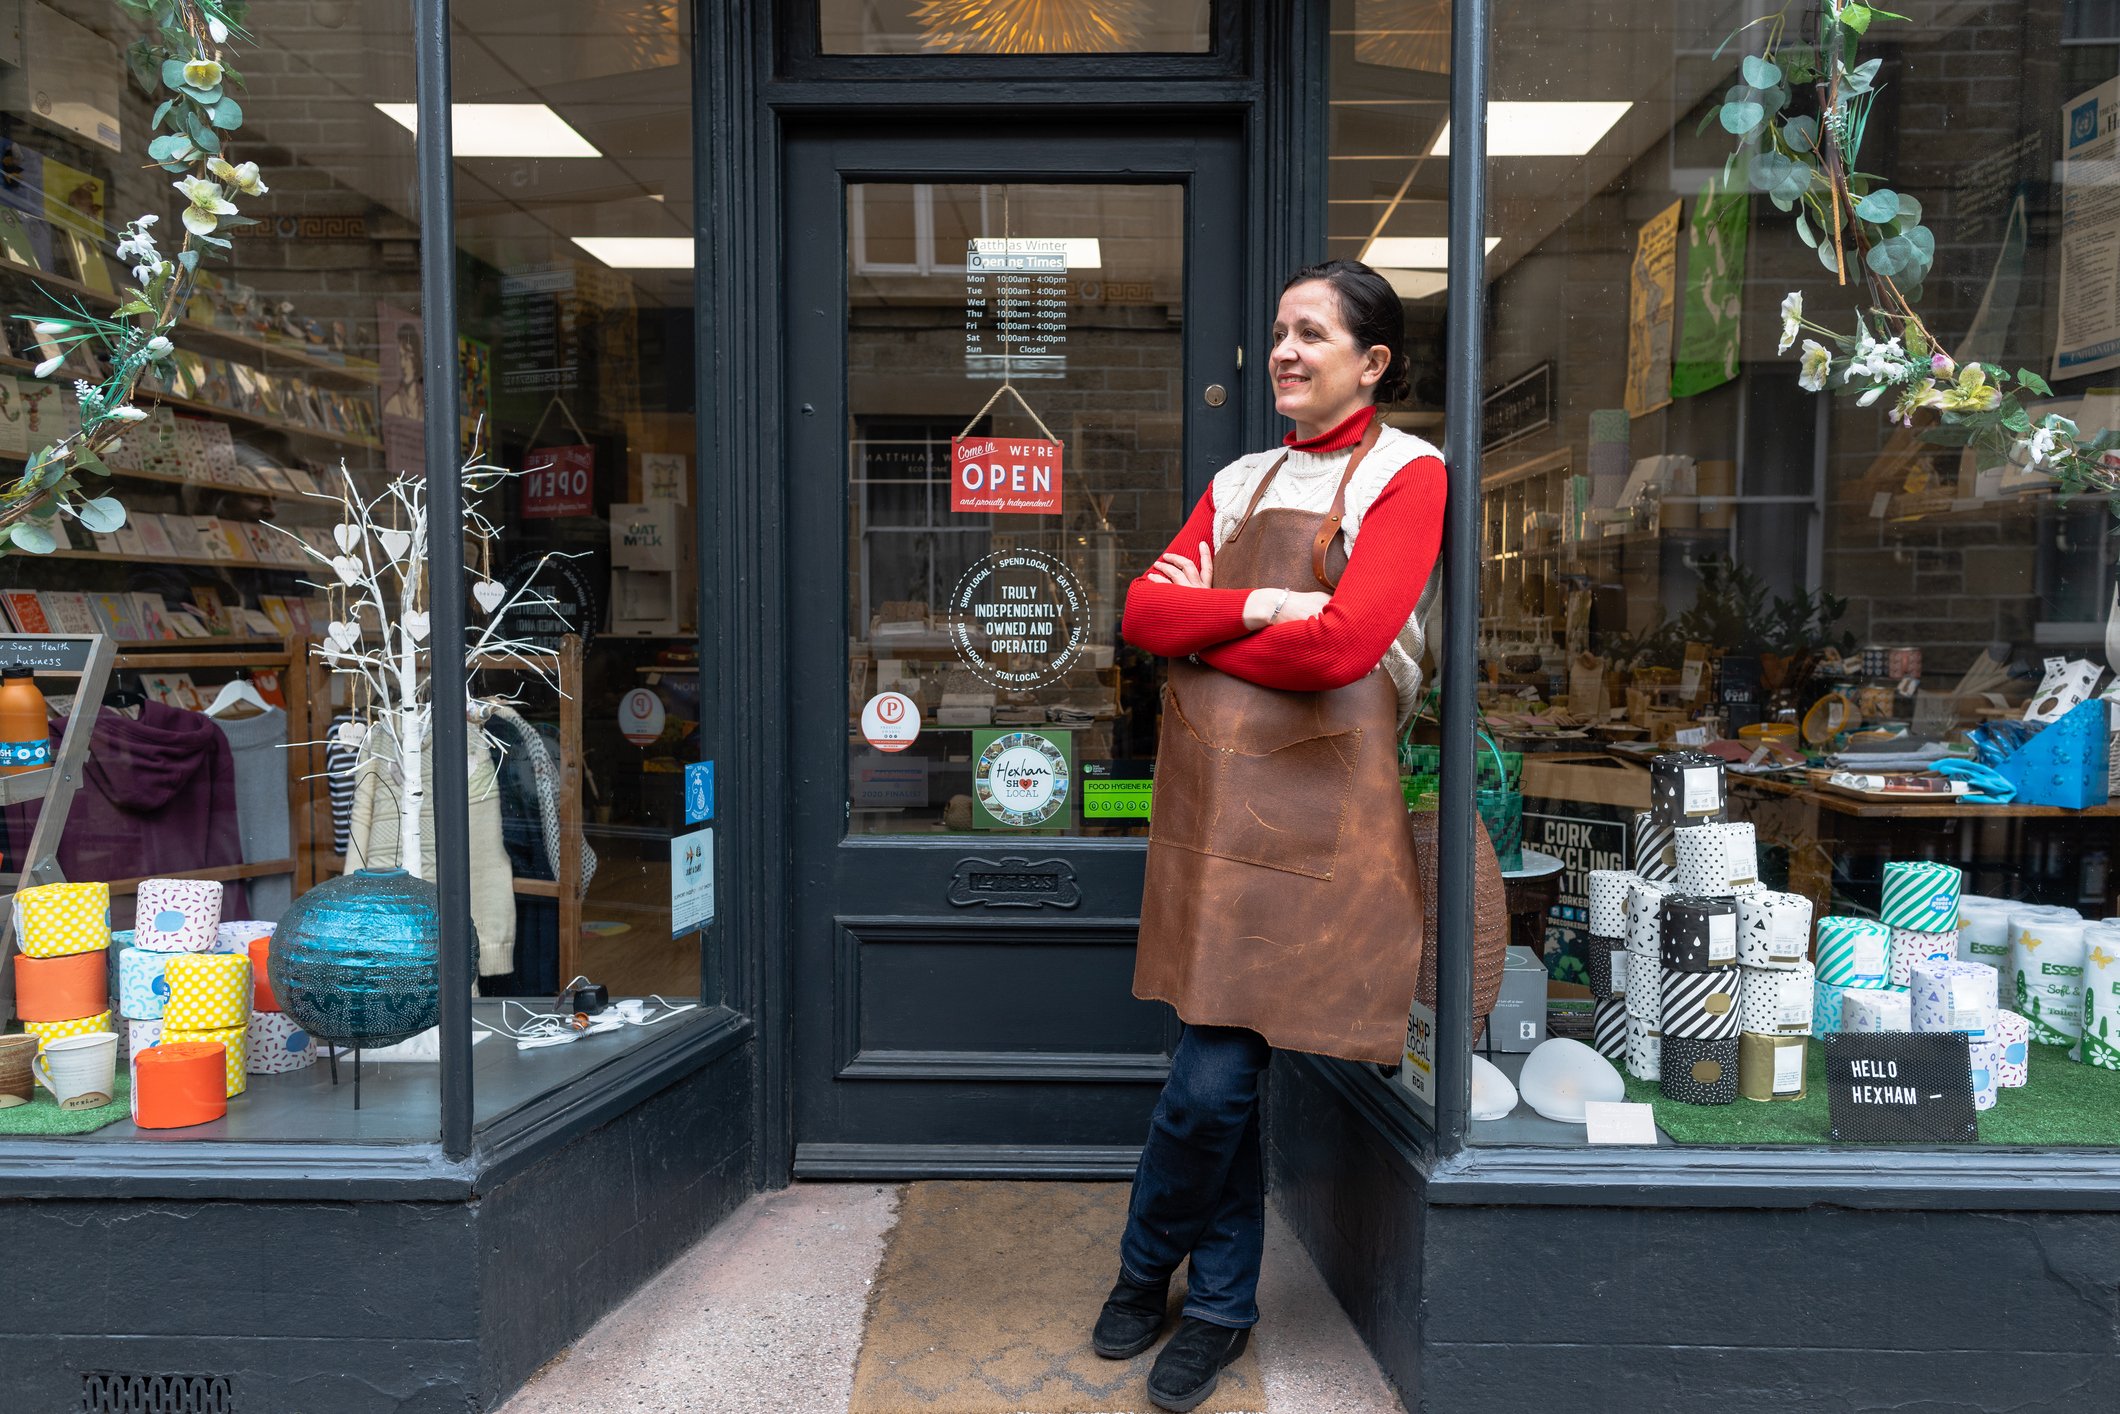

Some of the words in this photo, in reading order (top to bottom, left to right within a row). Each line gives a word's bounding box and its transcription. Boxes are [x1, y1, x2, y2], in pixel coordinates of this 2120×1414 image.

[968, 239, 1022, 251] Matthias
[1025, 239, 1067, 251] Winter
[972, 256, 1024, 270] Opening
[1026, 256, 1064, 268] Times
[967, 275, 986, 283] Mon
[996, 275, 1031, 284] 10:00am
[1036, 275, 1067, 285] 4:00pm
[967, 287, 983, 295] Tue
[996, 287, 1031, 296] 10:00am
[1036, 287, 1067, 297] 4:00pm
[967, 298, 986, 306] Wed
[996, 298, 1031, 307] 10:00am
[1036, 298, 1067, 308] 4:00pm
[966, 310, 983, 318] Thu
[996, 310, 1031, 319] 10:00am
[1036, 310, 1067, 320] 4:00pm
[966, 322, 978, 330] Fri
[996, 322, 1031, 331] 10:00am
[1036, 322, 1067, 332] 4:00pm
[966, 334, 981, 342] Sat
[996, 334, 1031, 343] 10:00am
[1036, 334, 1067, 344] 4:00pm
[966, 345, 982, 353] Sun
[1019, 345, 1047, 354] Closed
[957, 446, 984, 460] Come
[984, 442, 995, 455] in
[1009, 445, 1054, 457] WE'RE
[961, 463, 1051, 492] OPEN
[960, 497, 975, 507] and
[975, 498, 1006, 510] proudly
[999, 557, 1025, 568] SPEND
[1026, 558, 1050, 573] LOCAL
[960, 586, 971, 609] SHOP
[972, 567, 991, 589] LOCAL
[1001, 586, 1037, 599] TRULY
[1056, 574, 1069, 588] EAT
[1065, 586, 1080, 612] LOCAL
[974, 604, 1064, 617] INDEPENDENTLY
[986, 622, 1027, 635] OWNED
[1029, 622, 1053, 635] AND
[10, 643, 33, 651] Seas
[41, 642, 70, 651] Health
[957, 622, 971, 648] DRINK
[966, 647, 985, 669] LOCAL
[991, 640, 1048, 653] OPERATED
[1051, 649, 1071, 670] ENJOY
[1070, 626, 1082, 651] LOCAL
[16, 655, 62, 667] business
[995, 670, 1014, 681] STAY
[1015, 671, 1041, 682] LOCAL
[996, 759, 1052, 782] Hexham
[1006, 789, 1039, 798] LOCAL
[1544, 820, 1593, 849] CORK
[2047, 983, 2071, 998] Soft
[2072, 986, 2081, 997] &
[2048, 1007, 2078, 1018] Toilet
[1406, 1032, 1431, 1062] LOCAL
[1850, 1060, 1898, 1078] HELLO
[1852, 1086, 1917, 1105] HEXHAM
